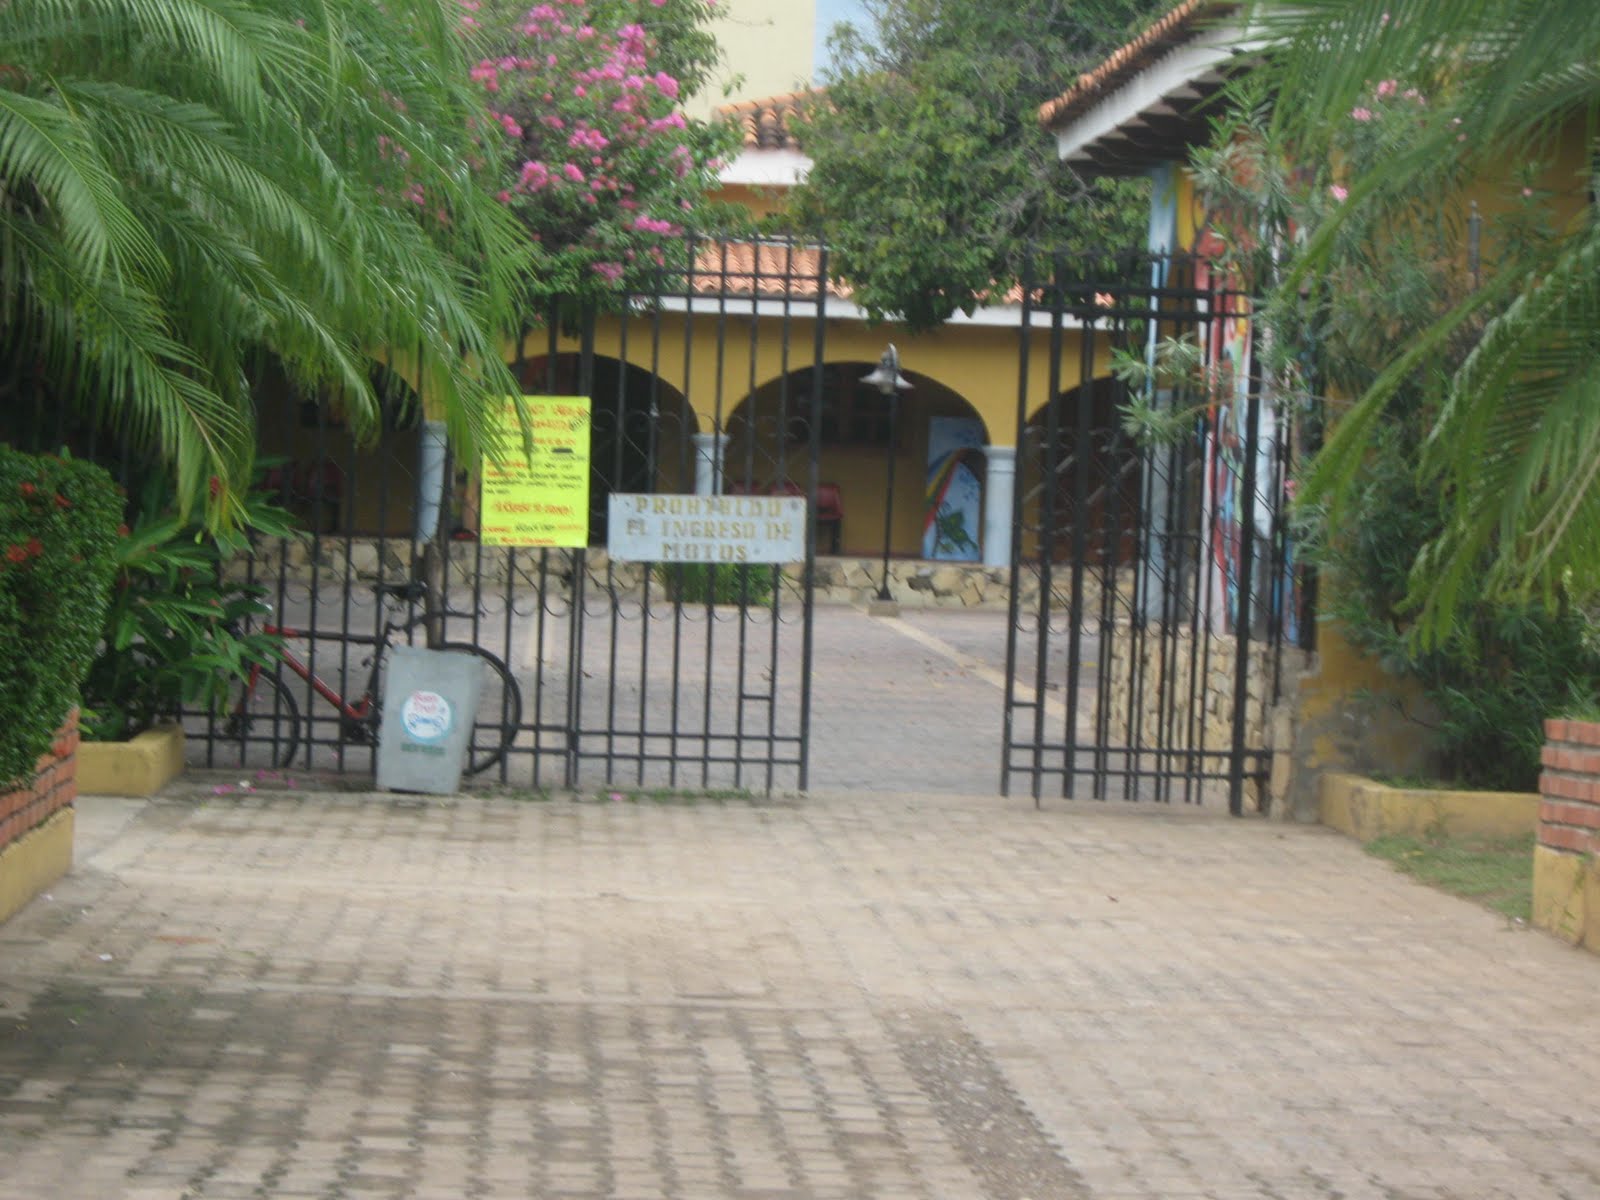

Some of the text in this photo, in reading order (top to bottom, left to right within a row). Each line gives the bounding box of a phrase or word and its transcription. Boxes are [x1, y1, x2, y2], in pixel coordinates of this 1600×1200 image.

[661, 520, 756, 539] INGRESO
[766, 521, 792, 541] DE
[663, 543, 748, 562] MOTOS
